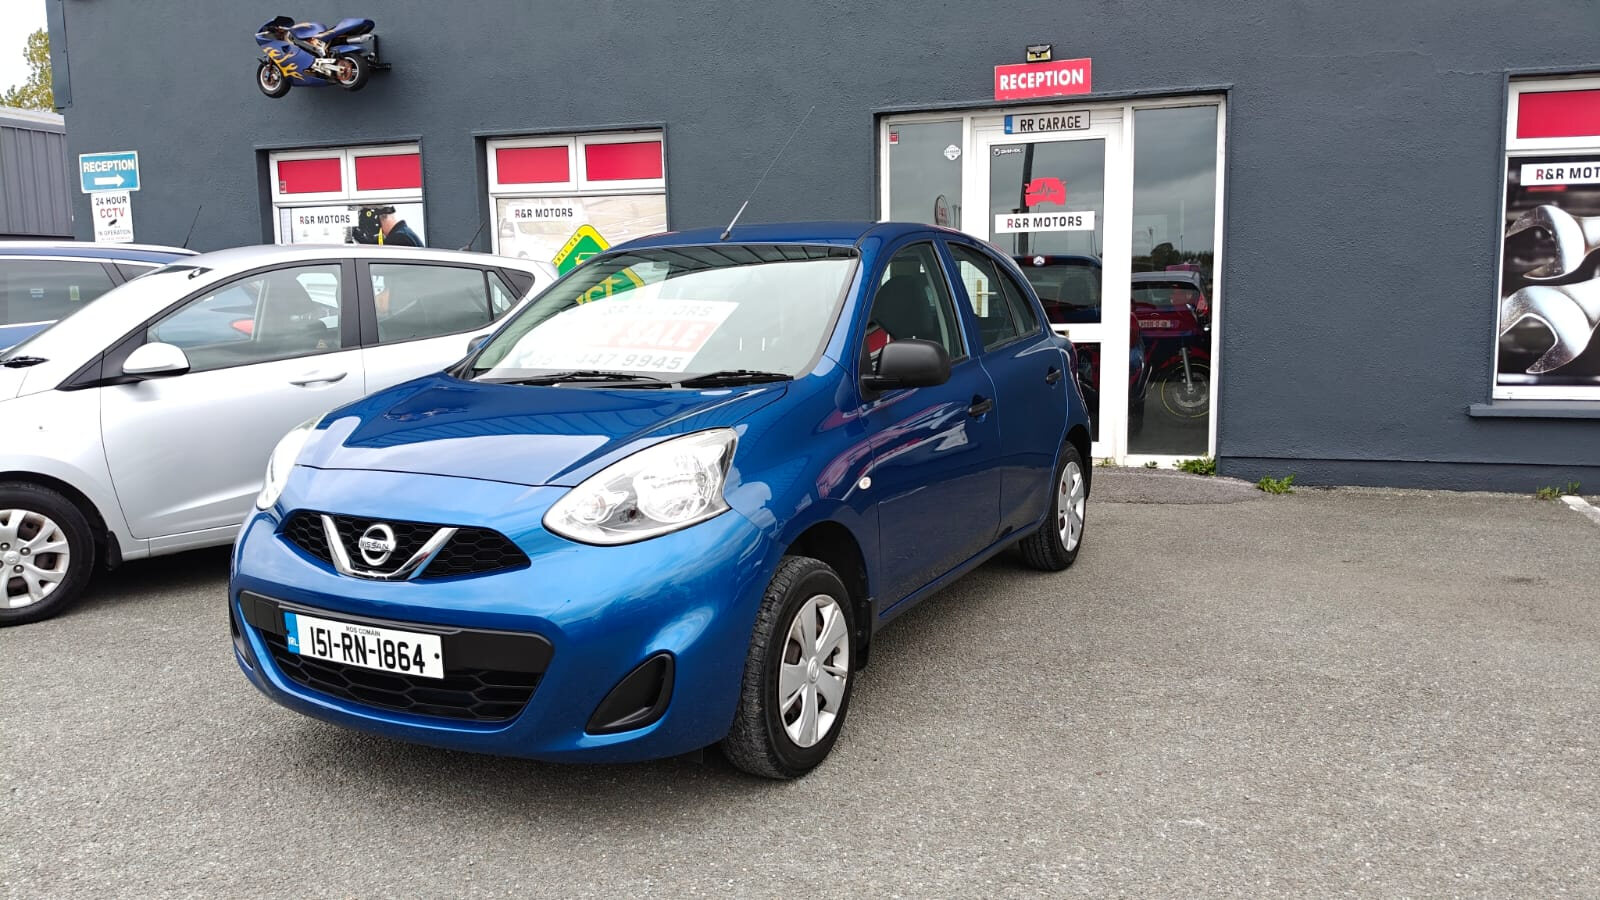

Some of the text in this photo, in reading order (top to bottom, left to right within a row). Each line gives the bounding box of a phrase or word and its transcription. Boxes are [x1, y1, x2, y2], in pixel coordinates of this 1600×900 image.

[1000, 68, 1084, 91] RECEPTION
[1020, 116, 1081, 132] RR GARAGE
[83, 159, 135, 173] RECEPTION
[1536, 168, 1564, 180] R&R
[95, 195, 128, 206] 24 HOUR
[100, 207, 125, 218] CCTV
[514, 207, 573, 218] R&R MOTORS
[300, 214, 351, 225] R&R MOTORS
[1007, 216, 1083, 229] R&R MOTORS
[621, 354, 685, 370] 9945
[360, 539, 390, 550] NISSAN
[310, 626, 425, 674] 151-RN-1864
